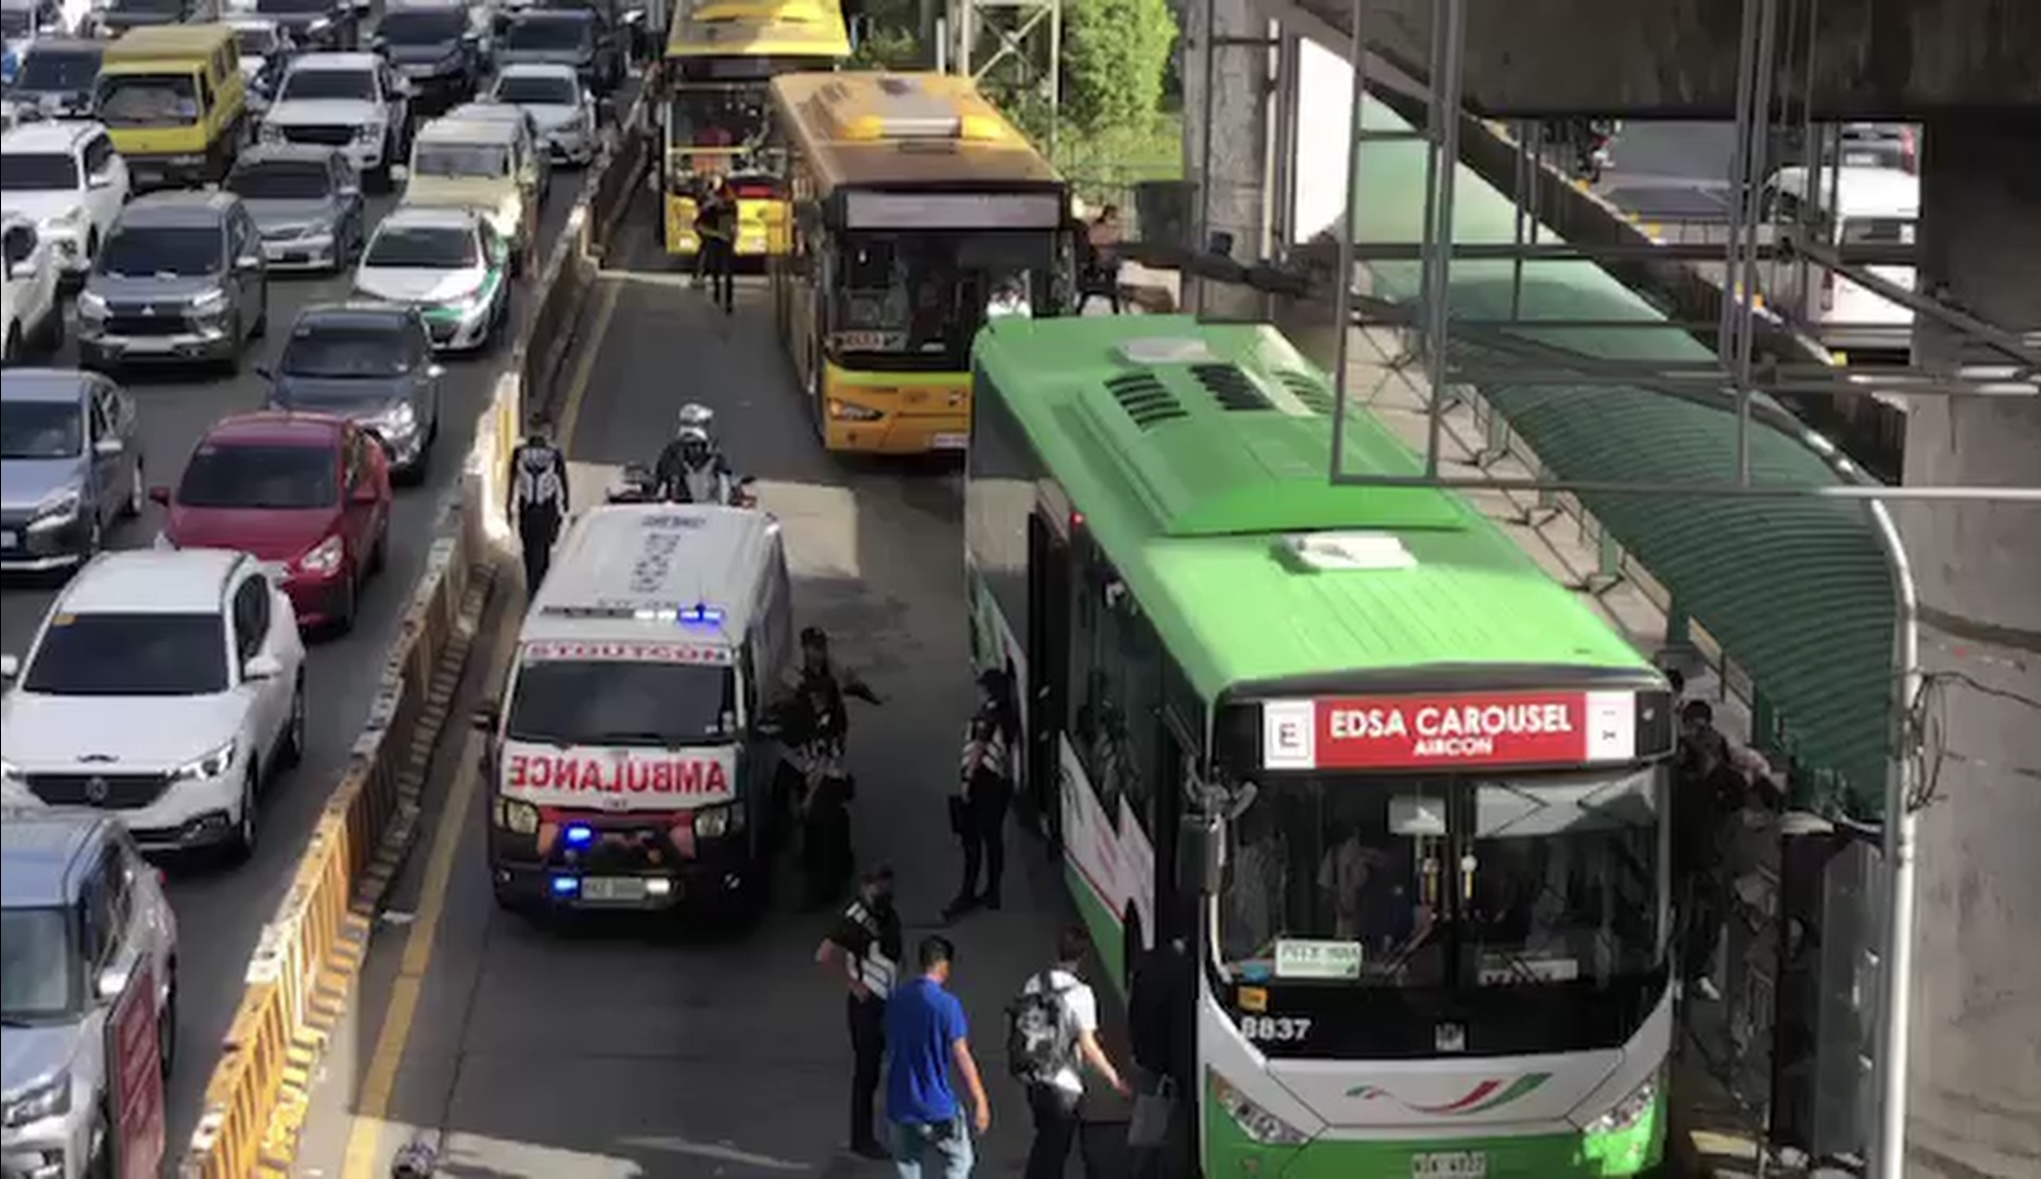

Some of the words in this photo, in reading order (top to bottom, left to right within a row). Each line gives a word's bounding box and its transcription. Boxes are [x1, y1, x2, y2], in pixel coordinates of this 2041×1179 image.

[1330, 708, 1408, 738] EDSA
[1415, 703, 1573, 736] CAROUSEL
[1413, 736, 1493, 756] AIRCON
